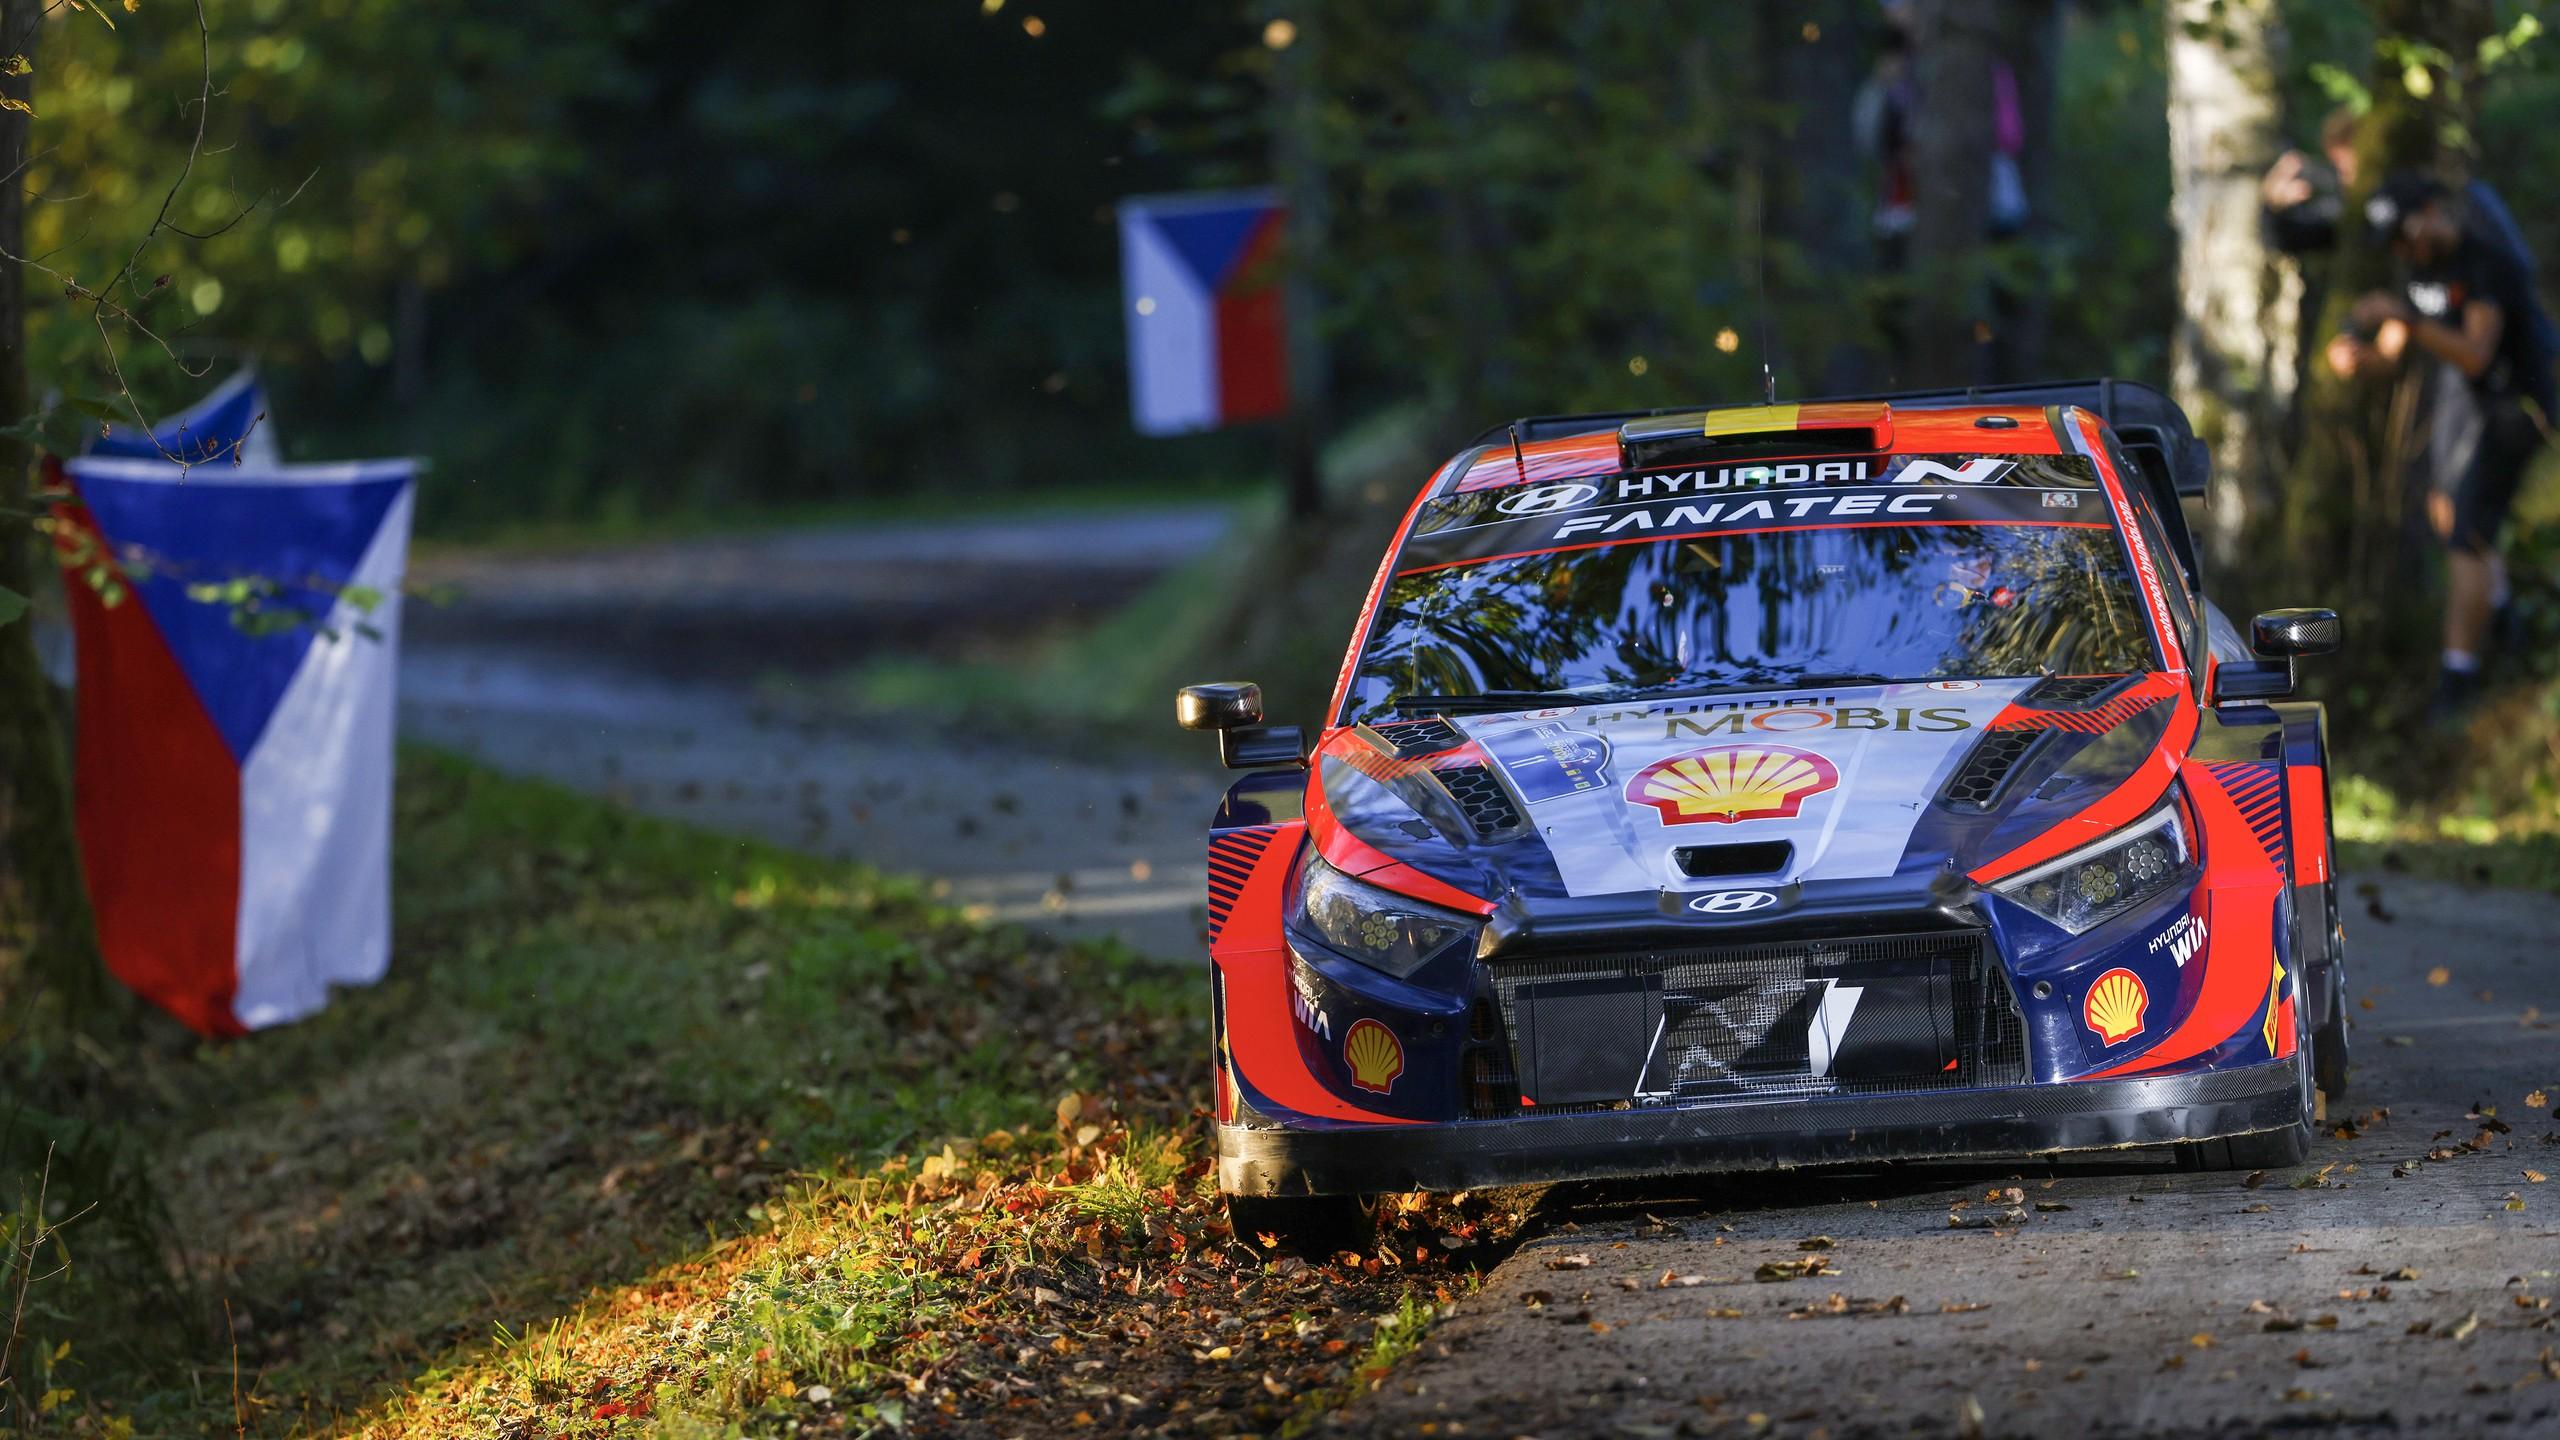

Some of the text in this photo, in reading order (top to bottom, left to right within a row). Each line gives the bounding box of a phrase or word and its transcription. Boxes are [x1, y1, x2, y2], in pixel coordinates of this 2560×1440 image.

[1618, 462, 1867, 498] HYUNDAI
[2118, 499, 2179, 649] motorsport.hyundai.com
[1587, 697, 1836, 726] HYUNDAI
[1664, 707, 1972, 739] MOBIS
[2148, 912, 2190, 955] HYUNDAI
